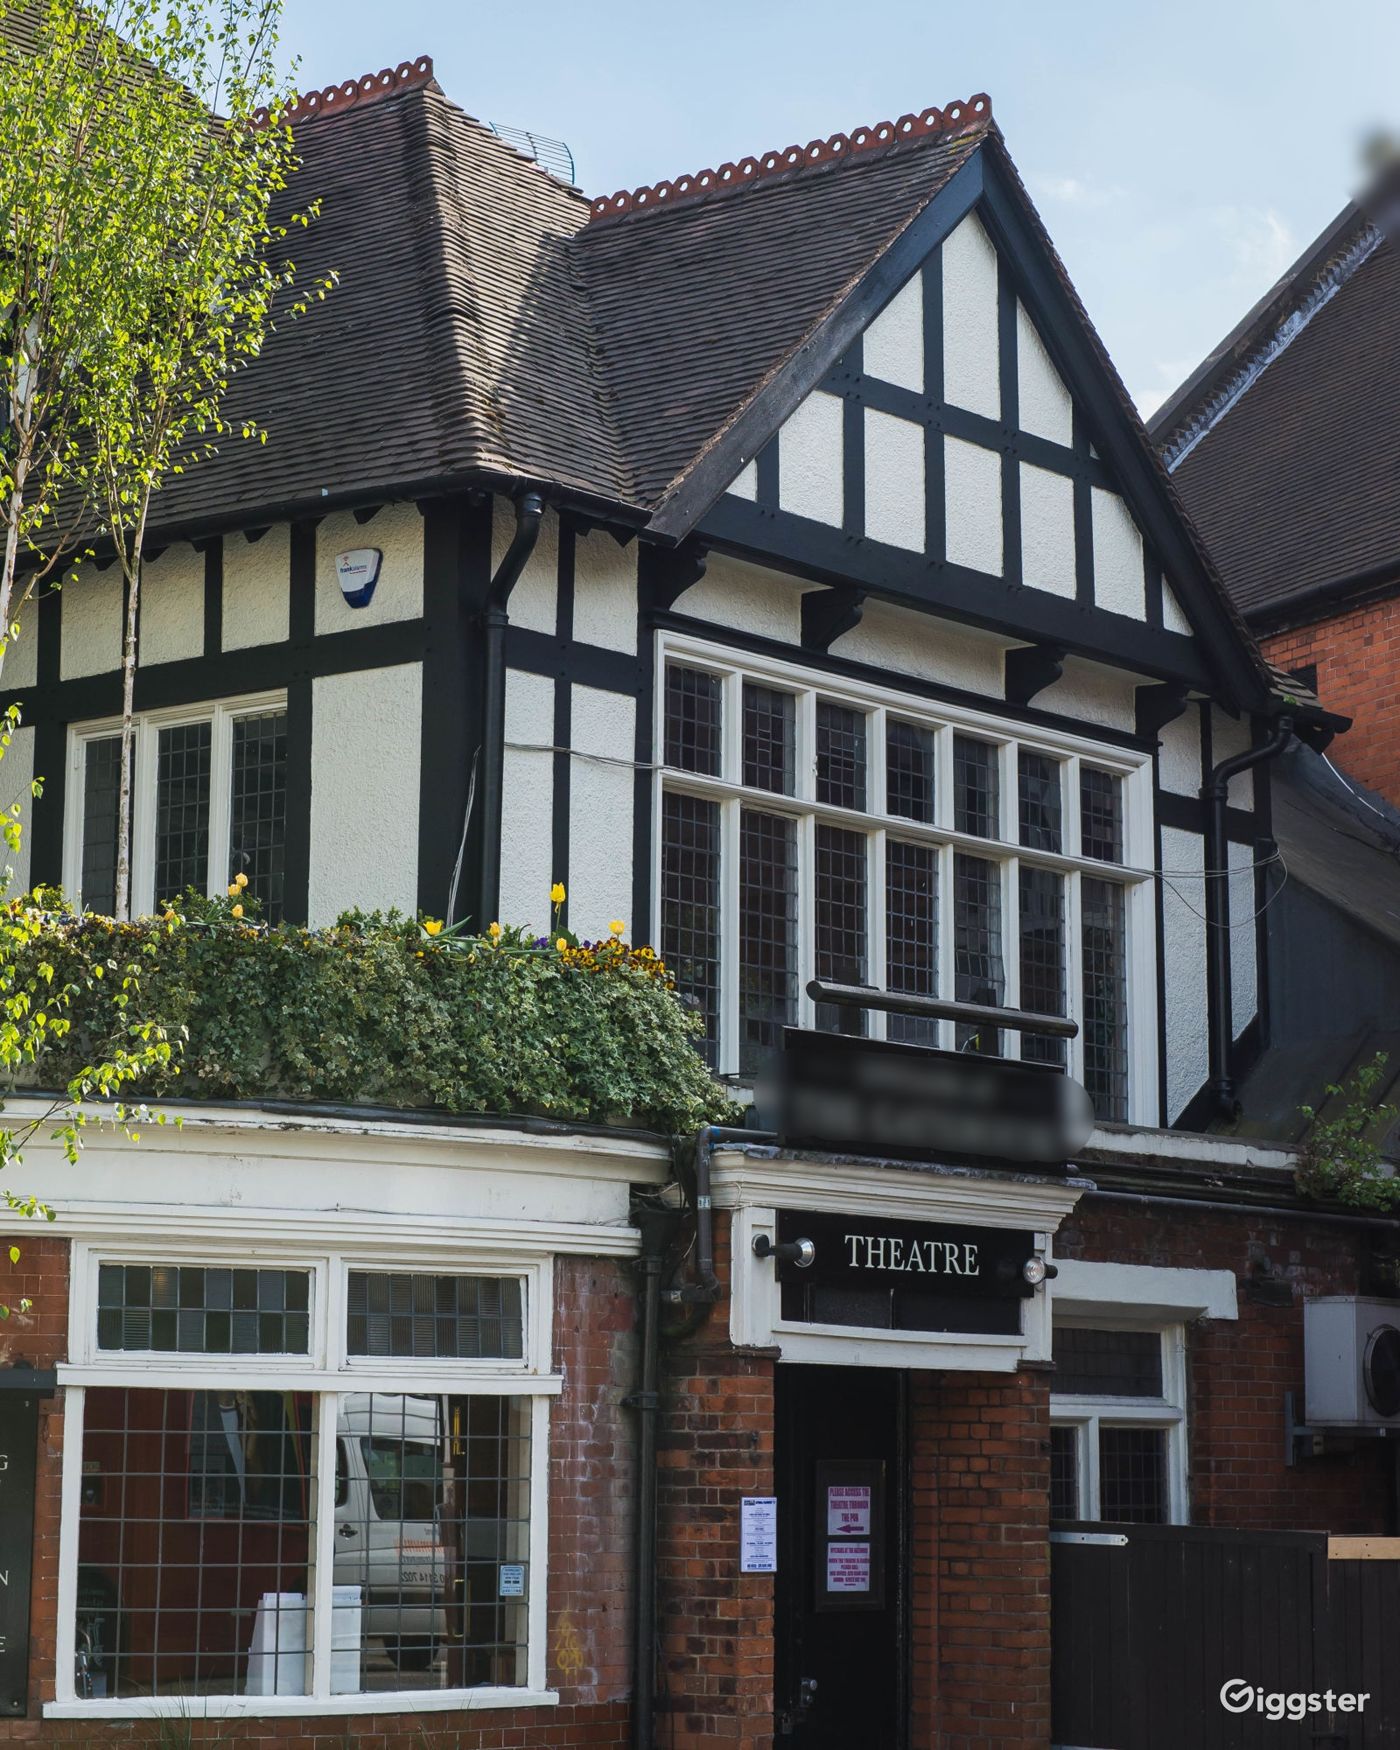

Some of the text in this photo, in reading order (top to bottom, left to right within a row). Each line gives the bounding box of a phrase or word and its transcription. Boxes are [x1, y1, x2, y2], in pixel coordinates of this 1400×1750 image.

[844, 1234, 980, 1276] THEATRE
[830, 1487, 844, 1496] PLEASE
[845, 1487, 861, 1496] ACCESS
[841, 1513, 849, 1522] THE
